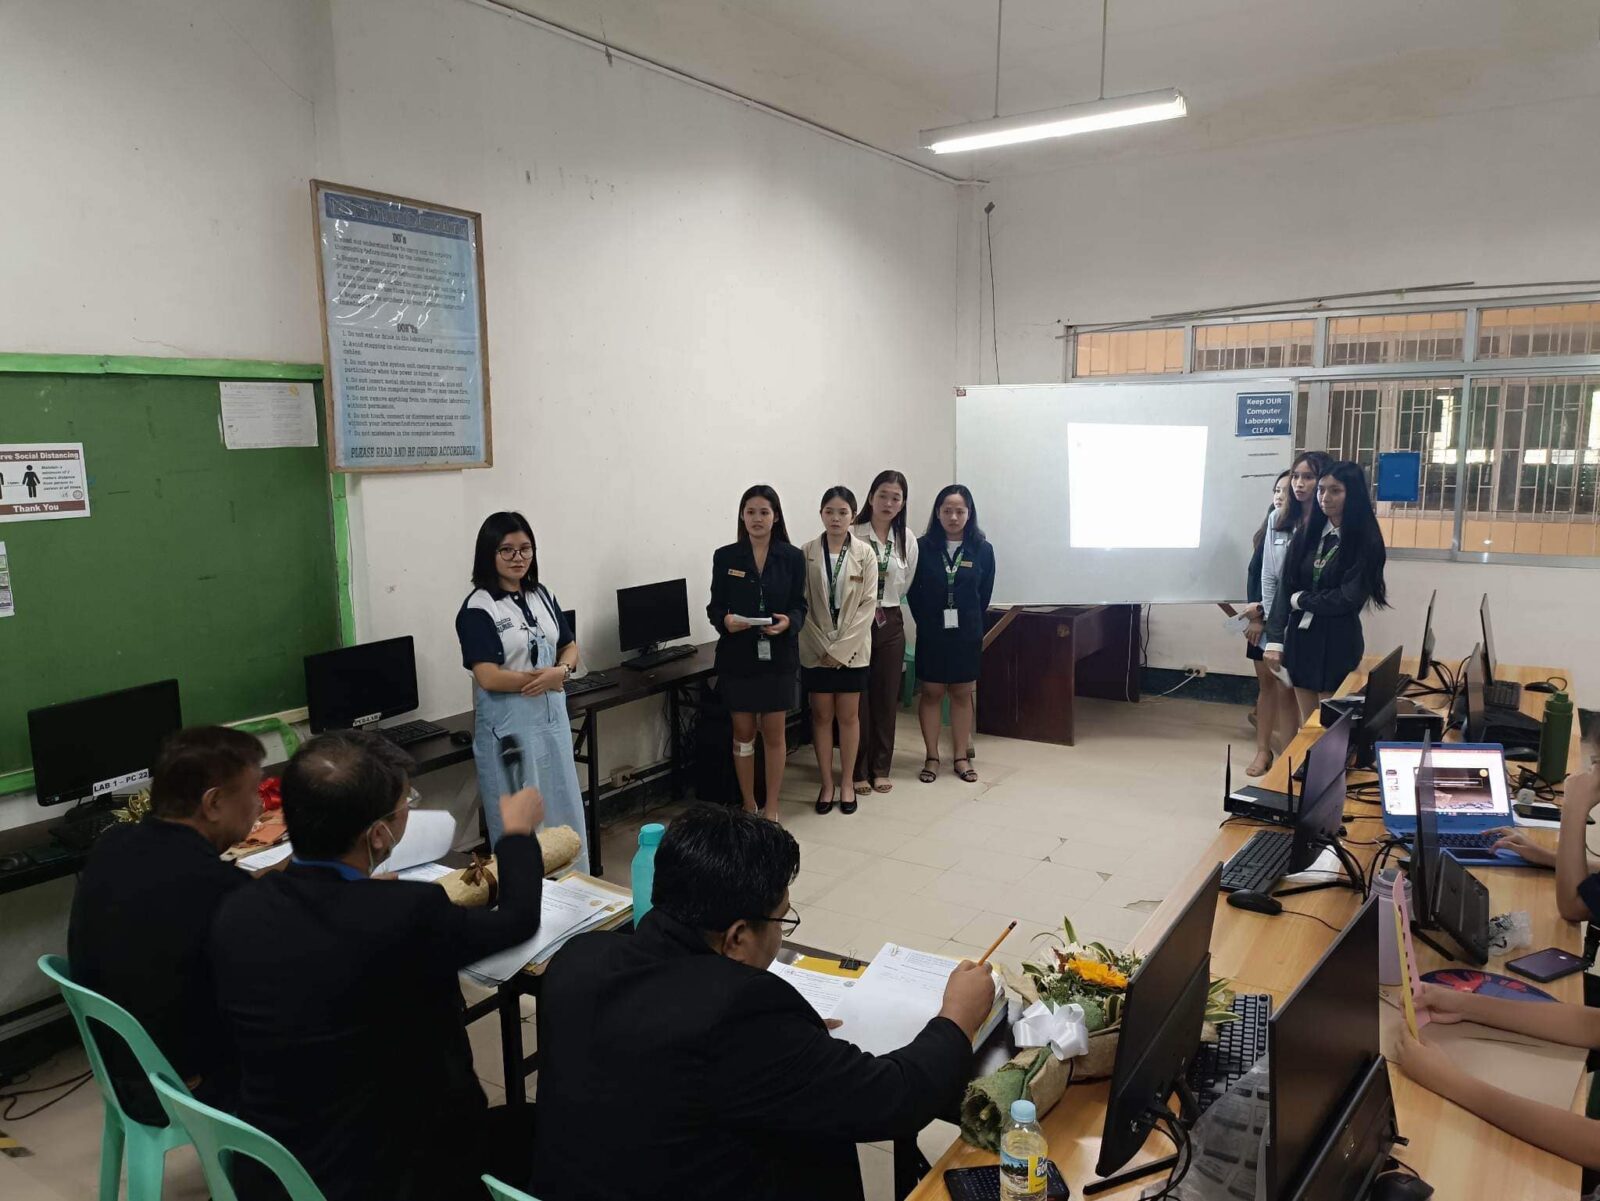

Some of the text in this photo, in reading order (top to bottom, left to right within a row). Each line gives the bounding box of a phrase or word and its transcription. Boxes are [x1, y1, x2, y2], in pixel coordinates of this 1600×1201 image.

[351, 447, 374, 458] PLEASE
[376, 447, 393, 457] READ
[394, 447, 406, 457] AND
[408, 446, 415, 456] BE
[417, 446, 438, 456] GUIDED
[13, 504, 41, 513] Thank
[94, 783, 110, 792] LAB
